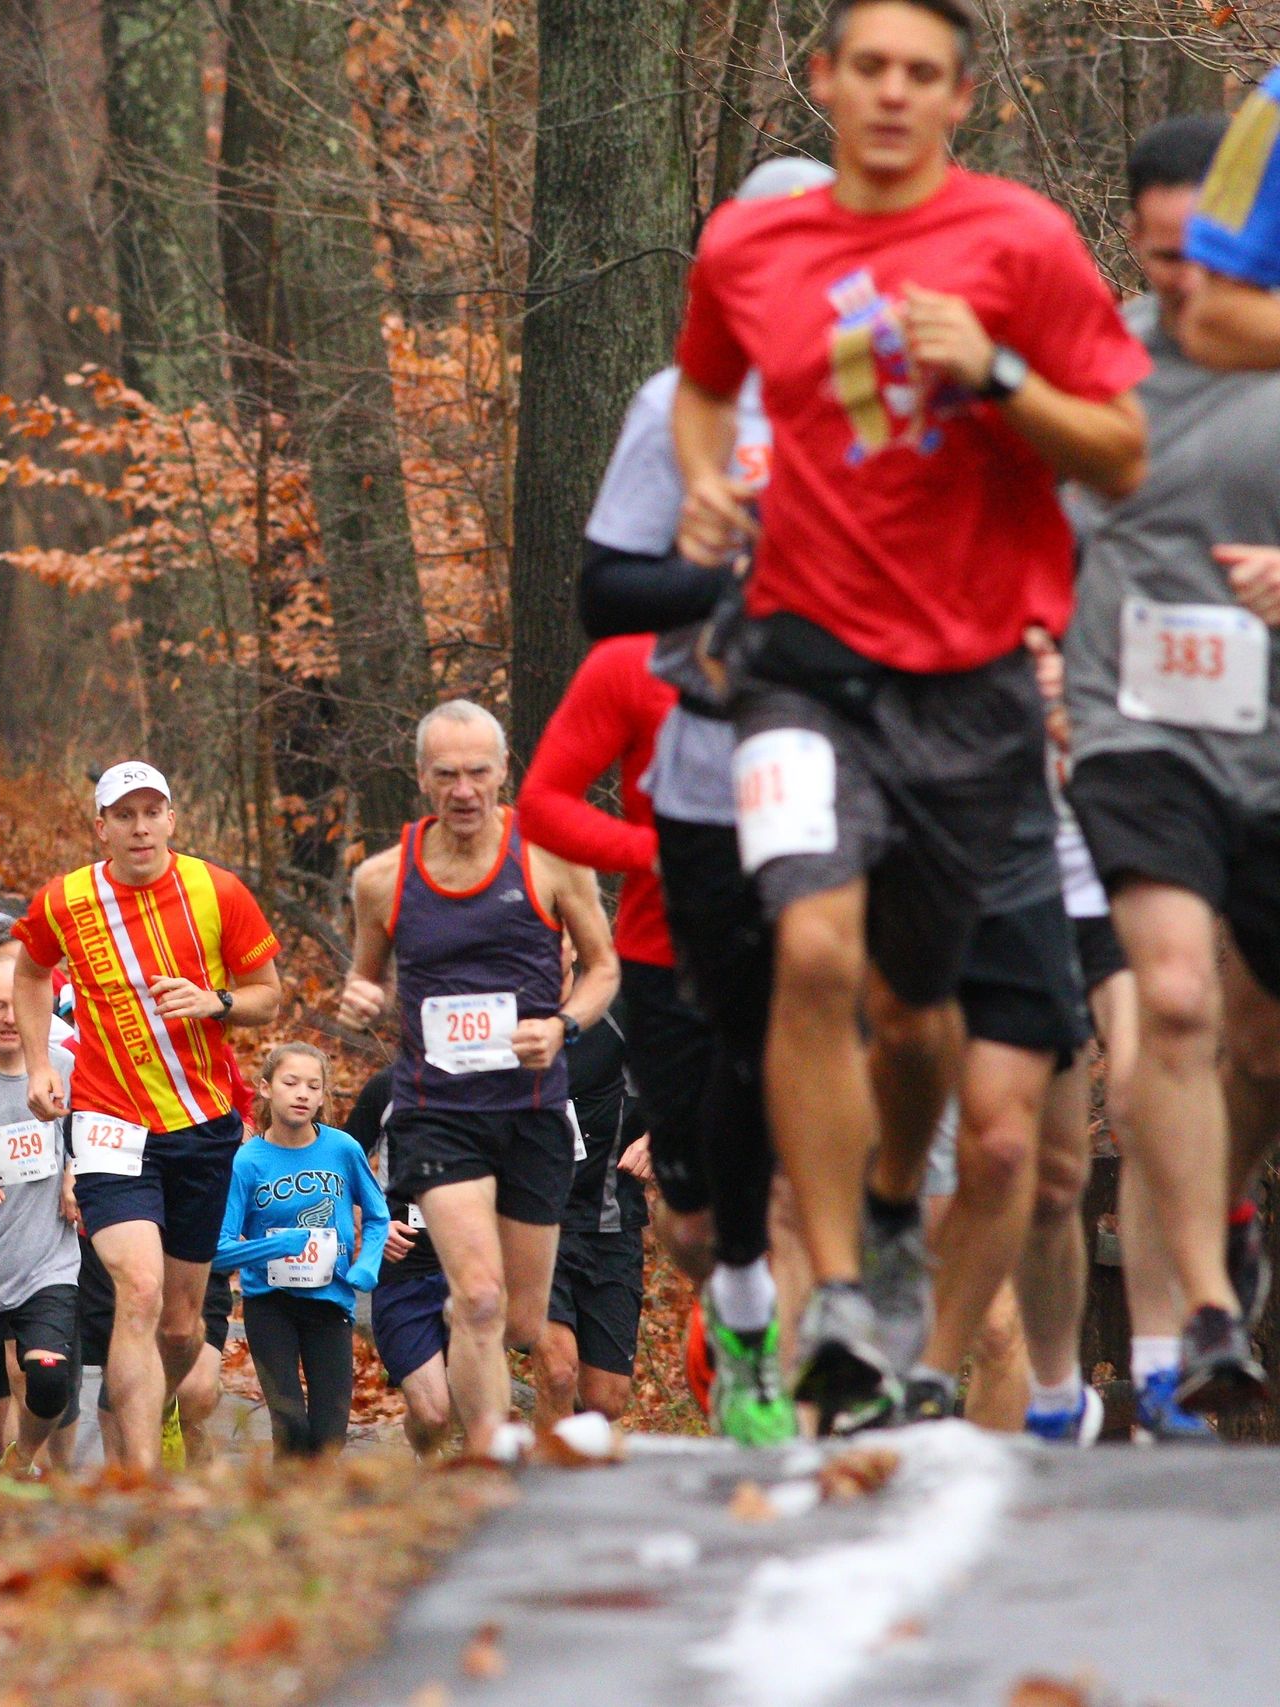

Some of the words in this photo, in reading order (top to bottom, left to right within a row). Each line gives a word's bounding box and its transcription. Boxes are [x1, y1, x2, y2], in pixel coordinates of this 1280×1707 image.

[123, 770, 148, 785] 50
[69, 895, 114, 976] montco
[100, 978, 153, 1067] runners
[446, 1011, 492, 1042] 269
[7, 1132, 43, 1160] 259
[87, 1124, 125, 1149] 423
